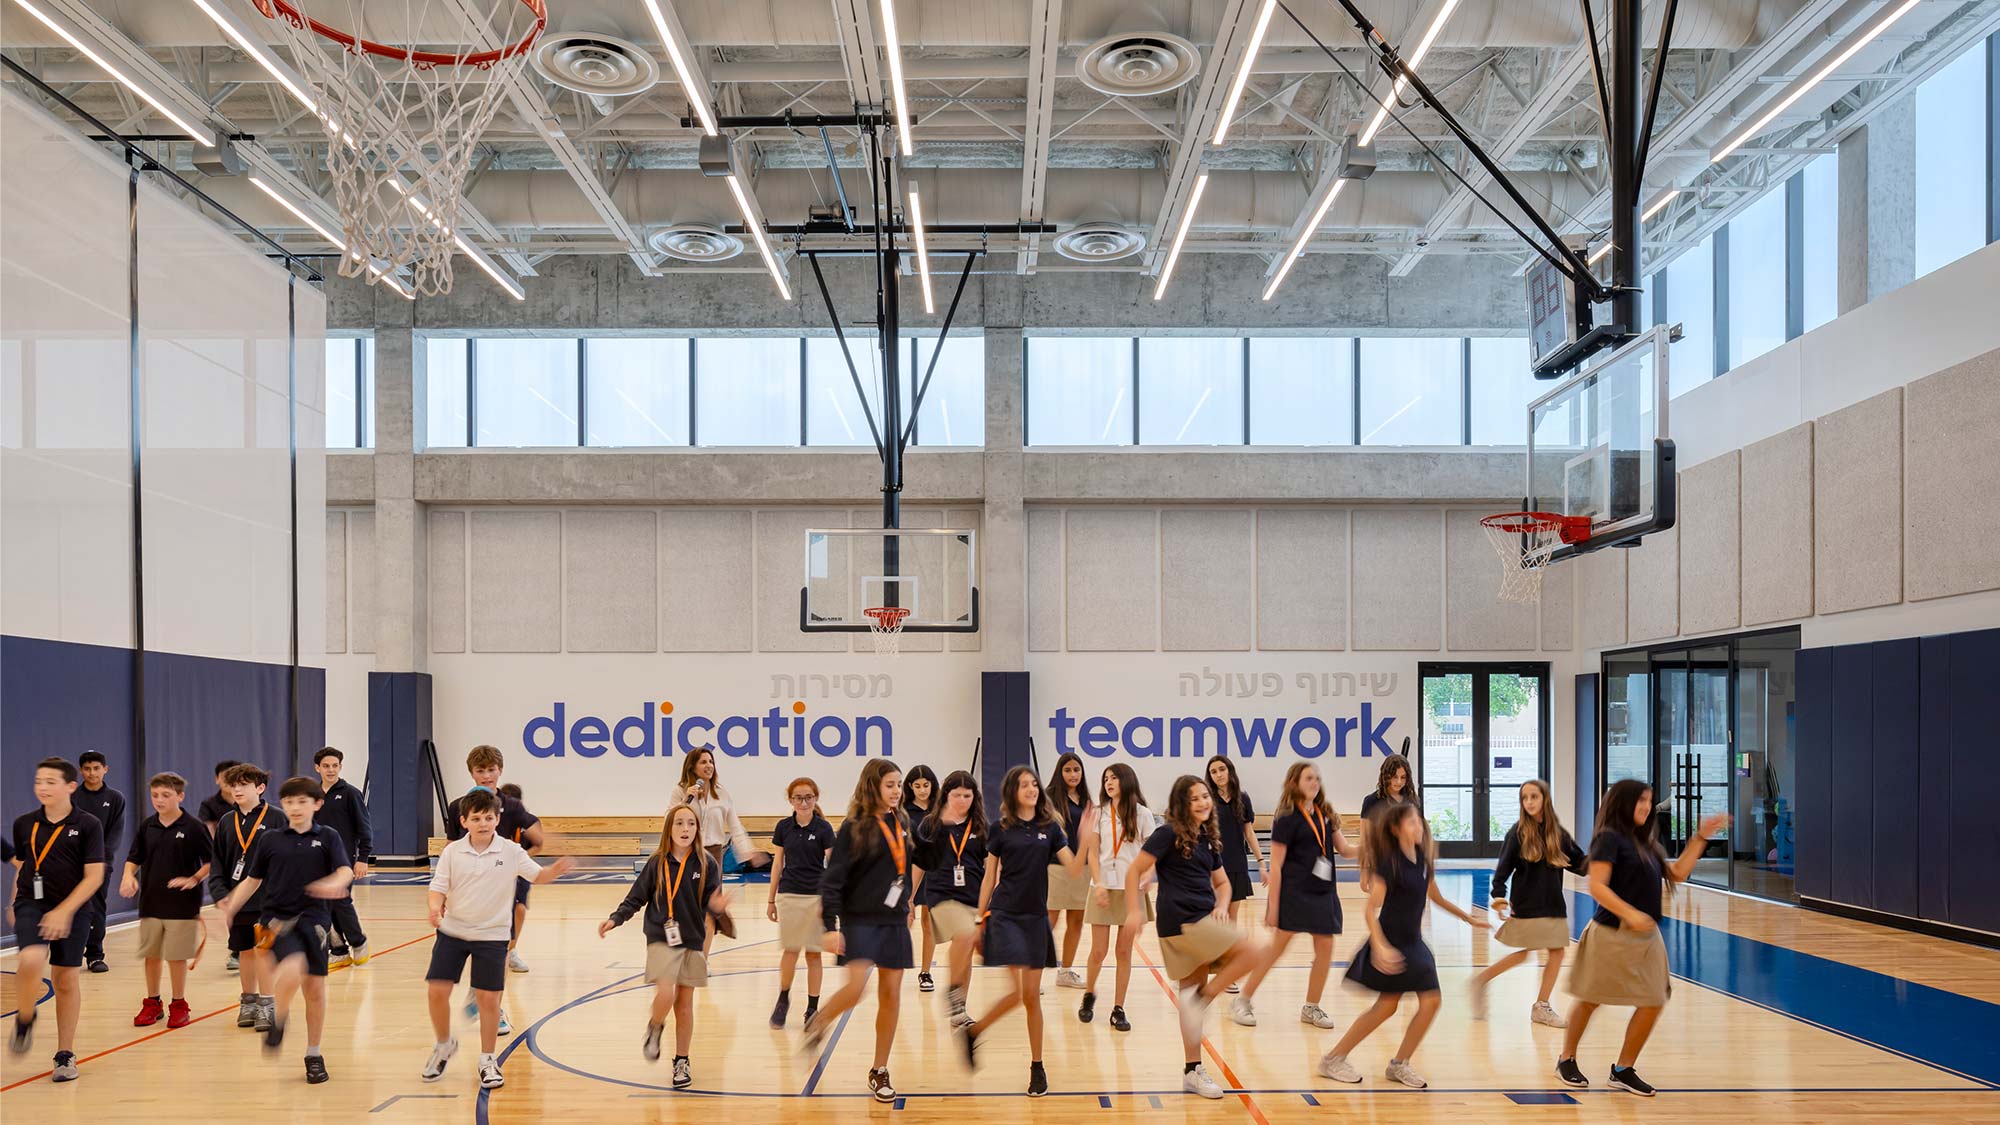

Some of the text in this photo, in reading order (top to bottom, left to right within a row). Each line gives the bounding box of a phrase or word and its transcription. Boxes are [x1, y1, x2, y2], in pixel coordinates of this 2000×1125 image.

[769, 673, 893, 699] מסירות
[1179, 666, 1398, 704] שיתוף פעולה
[523, 701, 893, 758] dedication
[1049, 702, 1396, 758] teamwork
